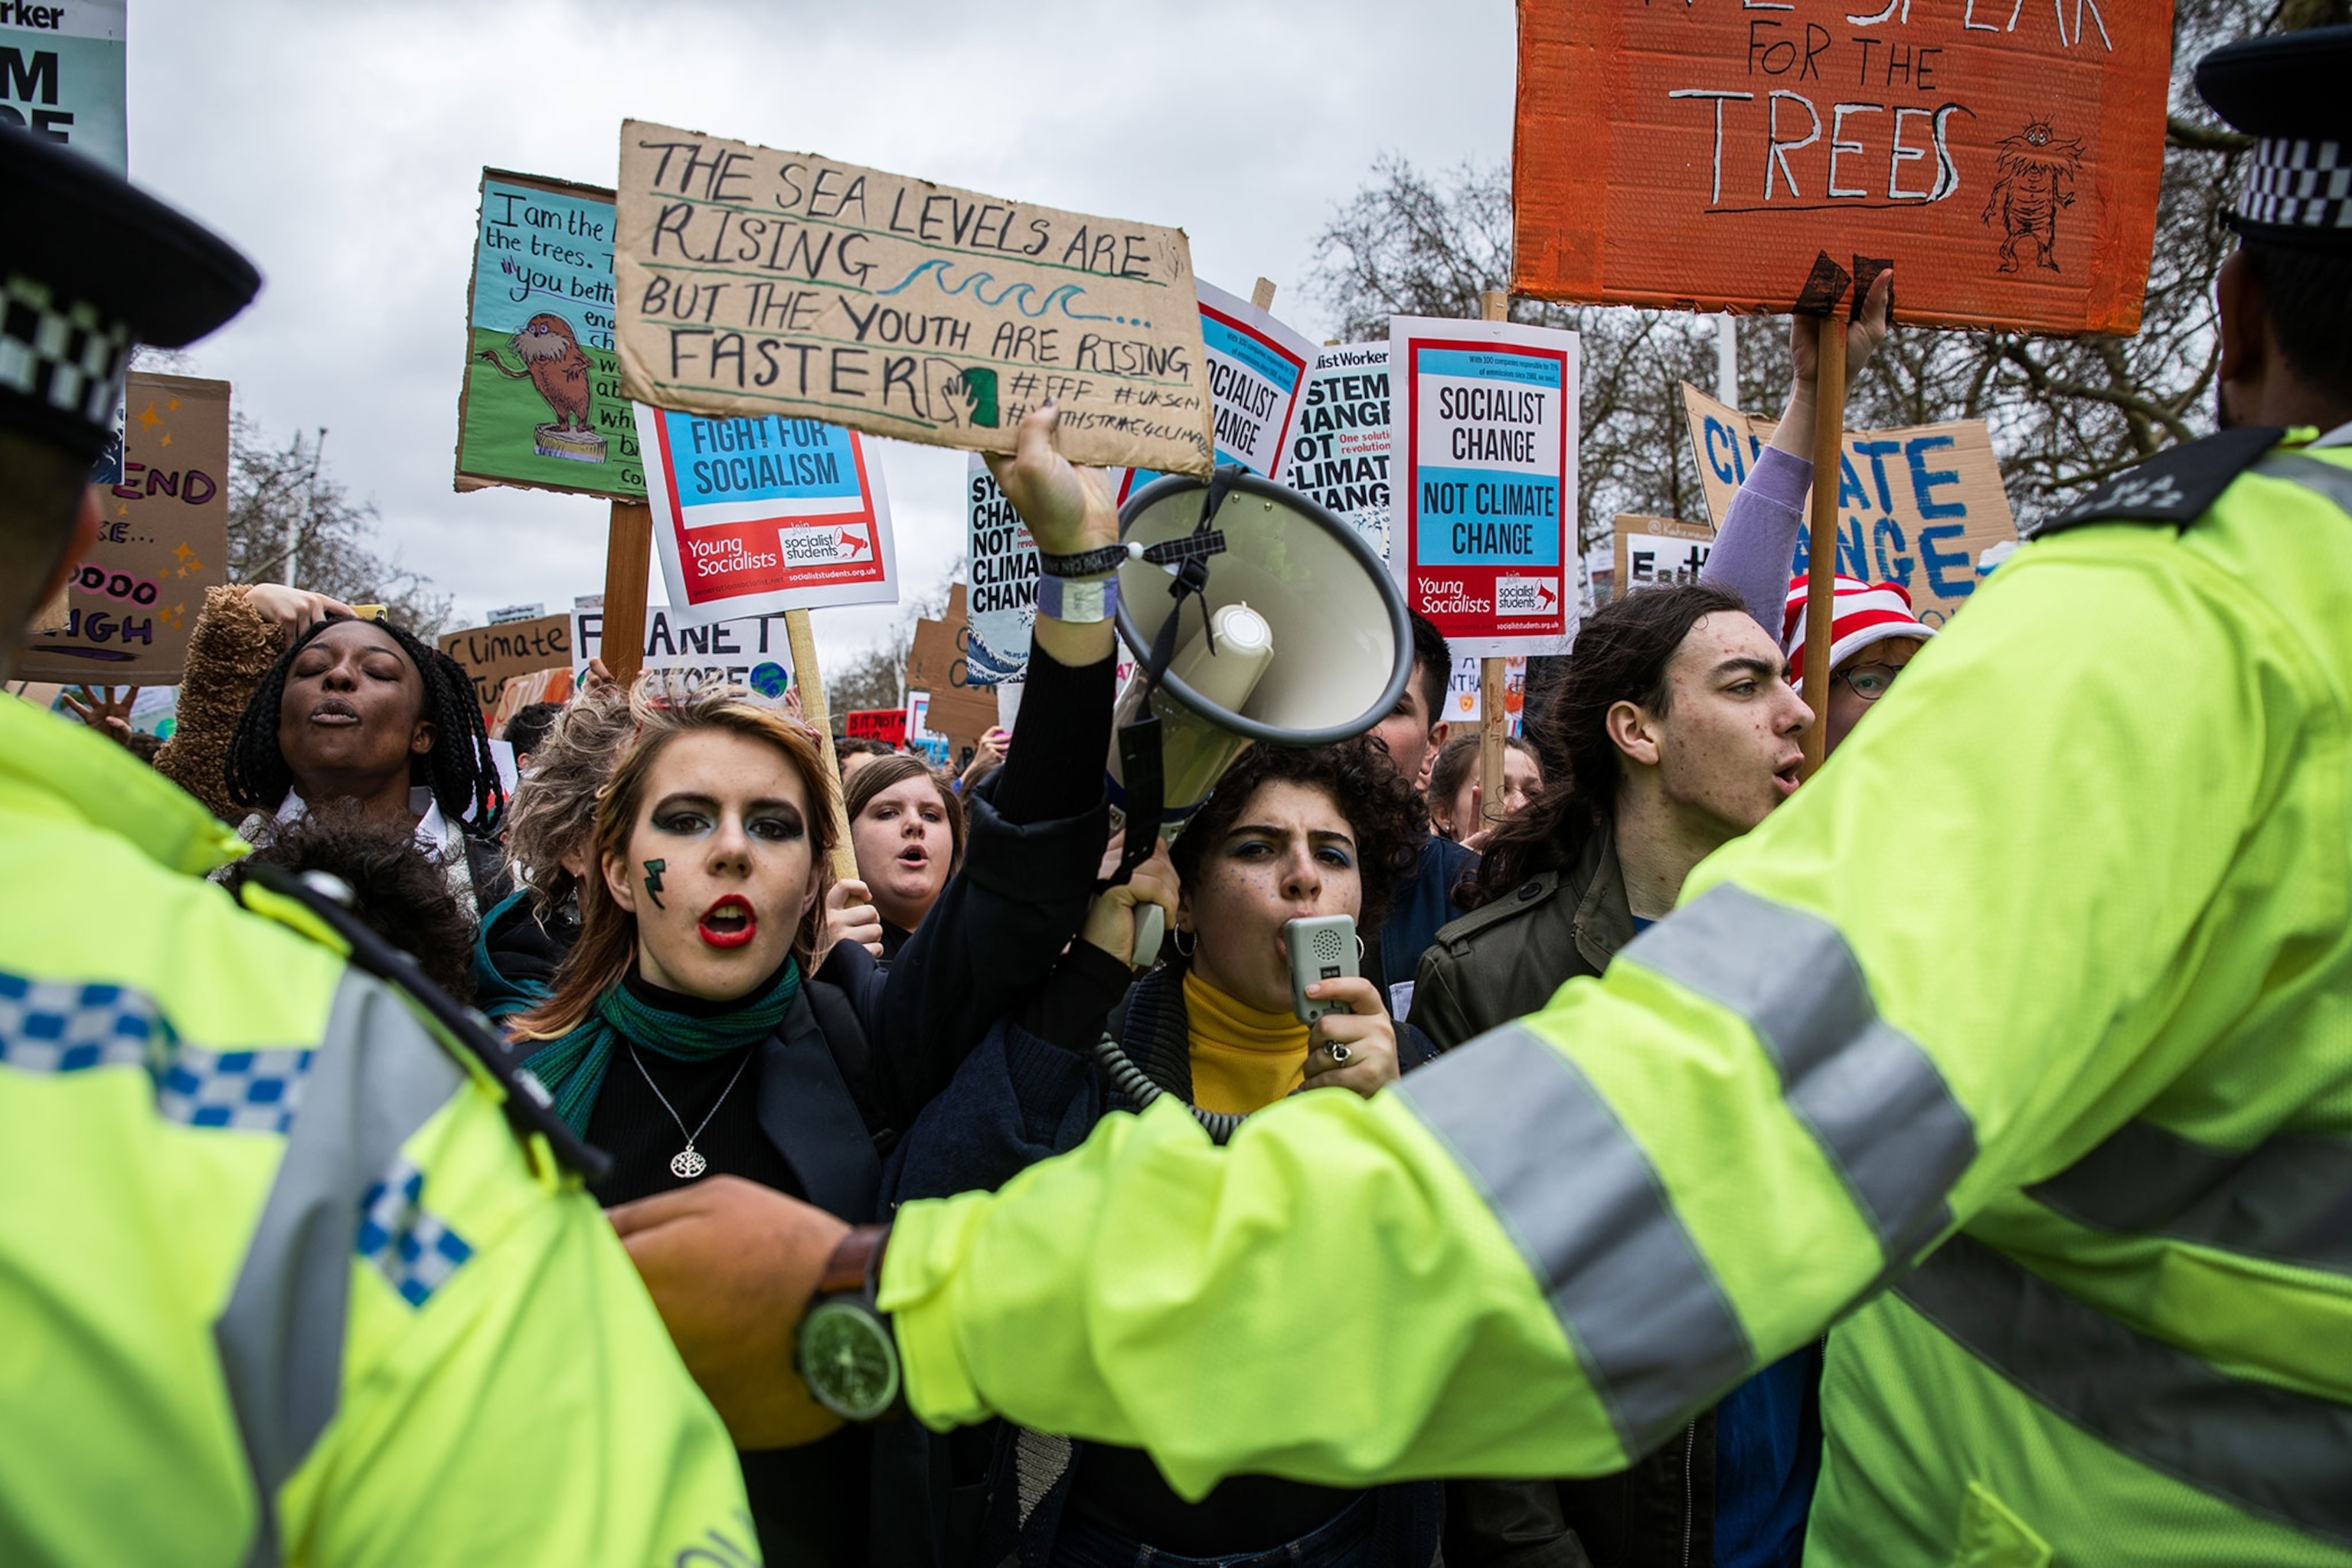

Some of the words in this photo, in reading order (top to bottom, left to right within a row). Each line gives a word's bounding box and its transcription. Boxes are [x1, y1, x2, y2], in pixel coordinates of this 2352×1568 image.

[1749, 21, 1831, 80] FOR
[1852, 38, 1943, 90] THE
[0, 46, 57, 106] M
[1669, 90, 1976, 204] TREES
[491, 193, 526, 227] I
[524, 207, 562, 230] am
[568, 210, 603, 241] the
[639, 140, 753, 201] THE
[776, 163, 866, 225] SEA
[890, 187, 1050, 256] LEVELS
[1063, 225, 1151, 277] ARE
[486, 226, 521, 251] the
[531, 234, 593, 269] trees.
[652, 202, 878, 286] RISING
[641, 275, 731, 323] BUT
[744, 283, 822, 332] THE
[838, 295, 971, 351] YOUTH
[991, 322, 1060, 364] ARE
[1076, 333, 1193, 382] RISING
[671, 329, 925, 418] FASTER
[1339, 351, 1389, 366] Worker
[1010, 371, 1093, 401] #FFF
[1440, 387, 1545, 425] SOCIALIST
[691, 417, 769, 454] FIGHT
[778, 416, 828, 449] FOR
[1290, 433, 1334, 463] OT
[1340, 433, 1359, 443] One
[1452, 427, 1535, 463] CHANGE
[112, 462, 216, 505] END
[694, 452, 840, 494] SOCIALISM
[972, 475, 1007, 503] SY
[1288, 455, 1390, 491] LIMAT
[972, 500, 1020, 531] CHA
[1424, 482, 1468, 514] NOT
[1475, 482, 1554, 518] CLIMATE
[688, 537, 743, 560] Young
[784, 534, 833, 550] socialist
[786, 544, 838, 560] students
[974, 527, 1014, 558] NOT
[1452, 523, 1533, 554] CHANGE
[697, 551, 777, 577] Socialists
[789, 567, 877, 582] socialiststudents.org.uk
[972, 551, 1040, 586] CLIMA
[1418, 577, 1463, 599] Young
[1422, 595, 1490, 613] Socialists
[1498, 586, 1534, 598] socialist
[1499, 597, 1535, 608] students
[449, 627, 570, 666] Climate
[578, 612, 786, 658] PANET
